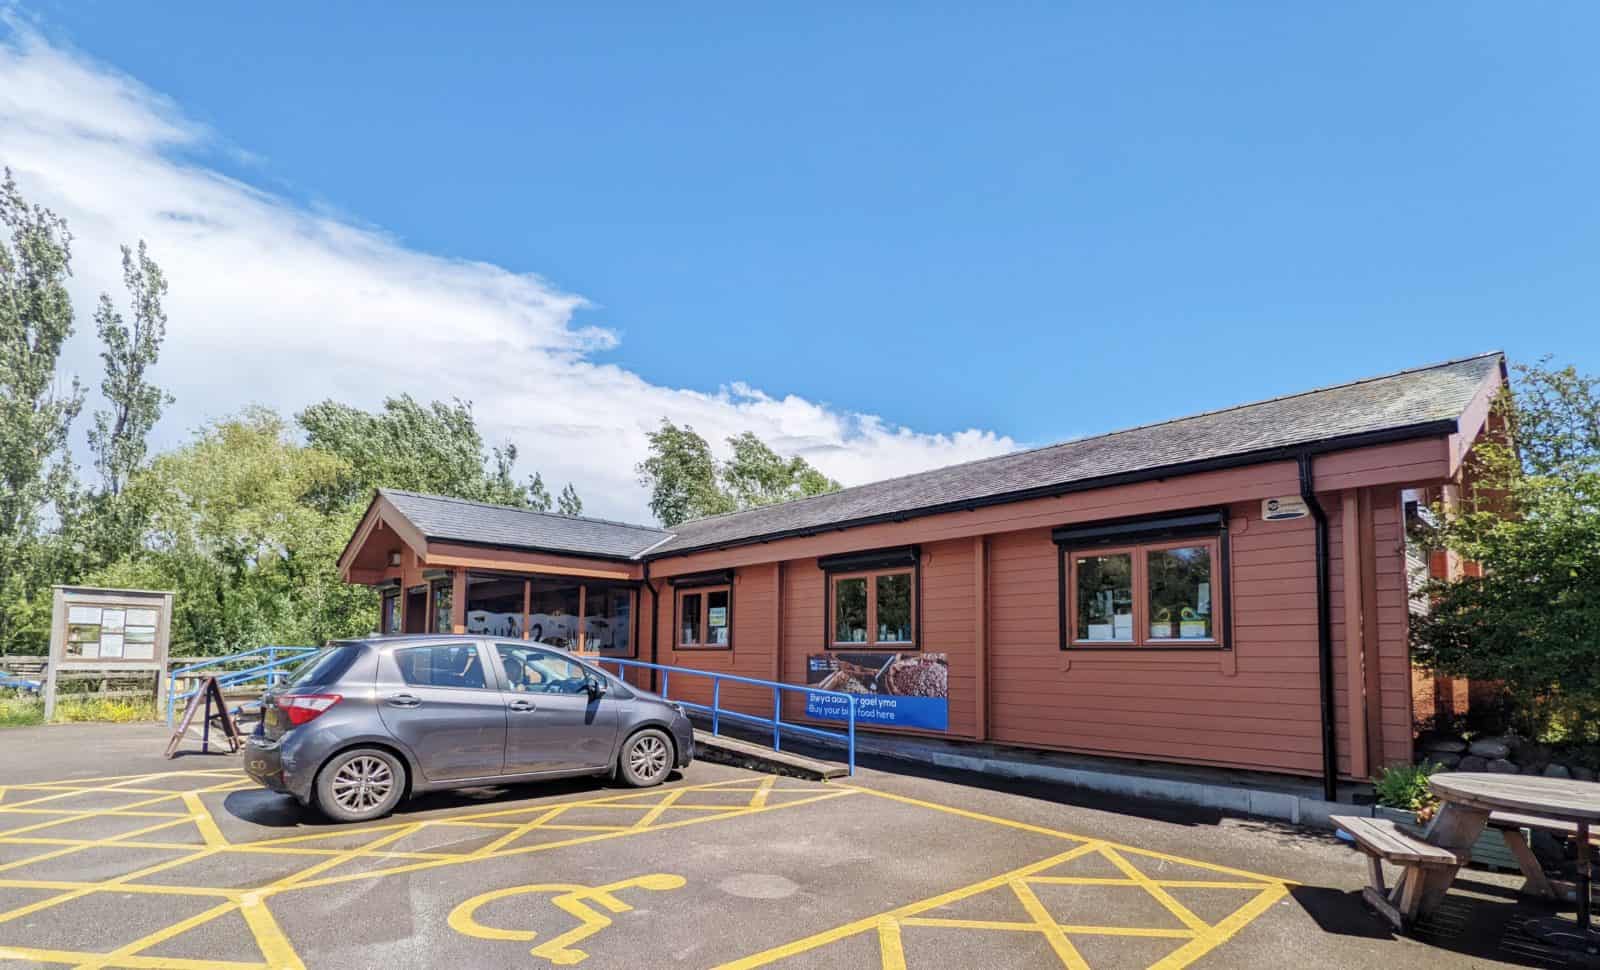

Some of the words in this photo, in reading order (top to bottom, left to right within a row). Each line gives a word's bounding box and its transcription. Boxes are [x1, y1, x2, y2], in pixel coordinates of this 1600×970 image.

[878, 699, 897, 709] yma
[808, 704, 823, 715] Buy
[824, 707, 841, 717] your
[857, 707, 876, 718] food
[876, 709, 895, 720] here
